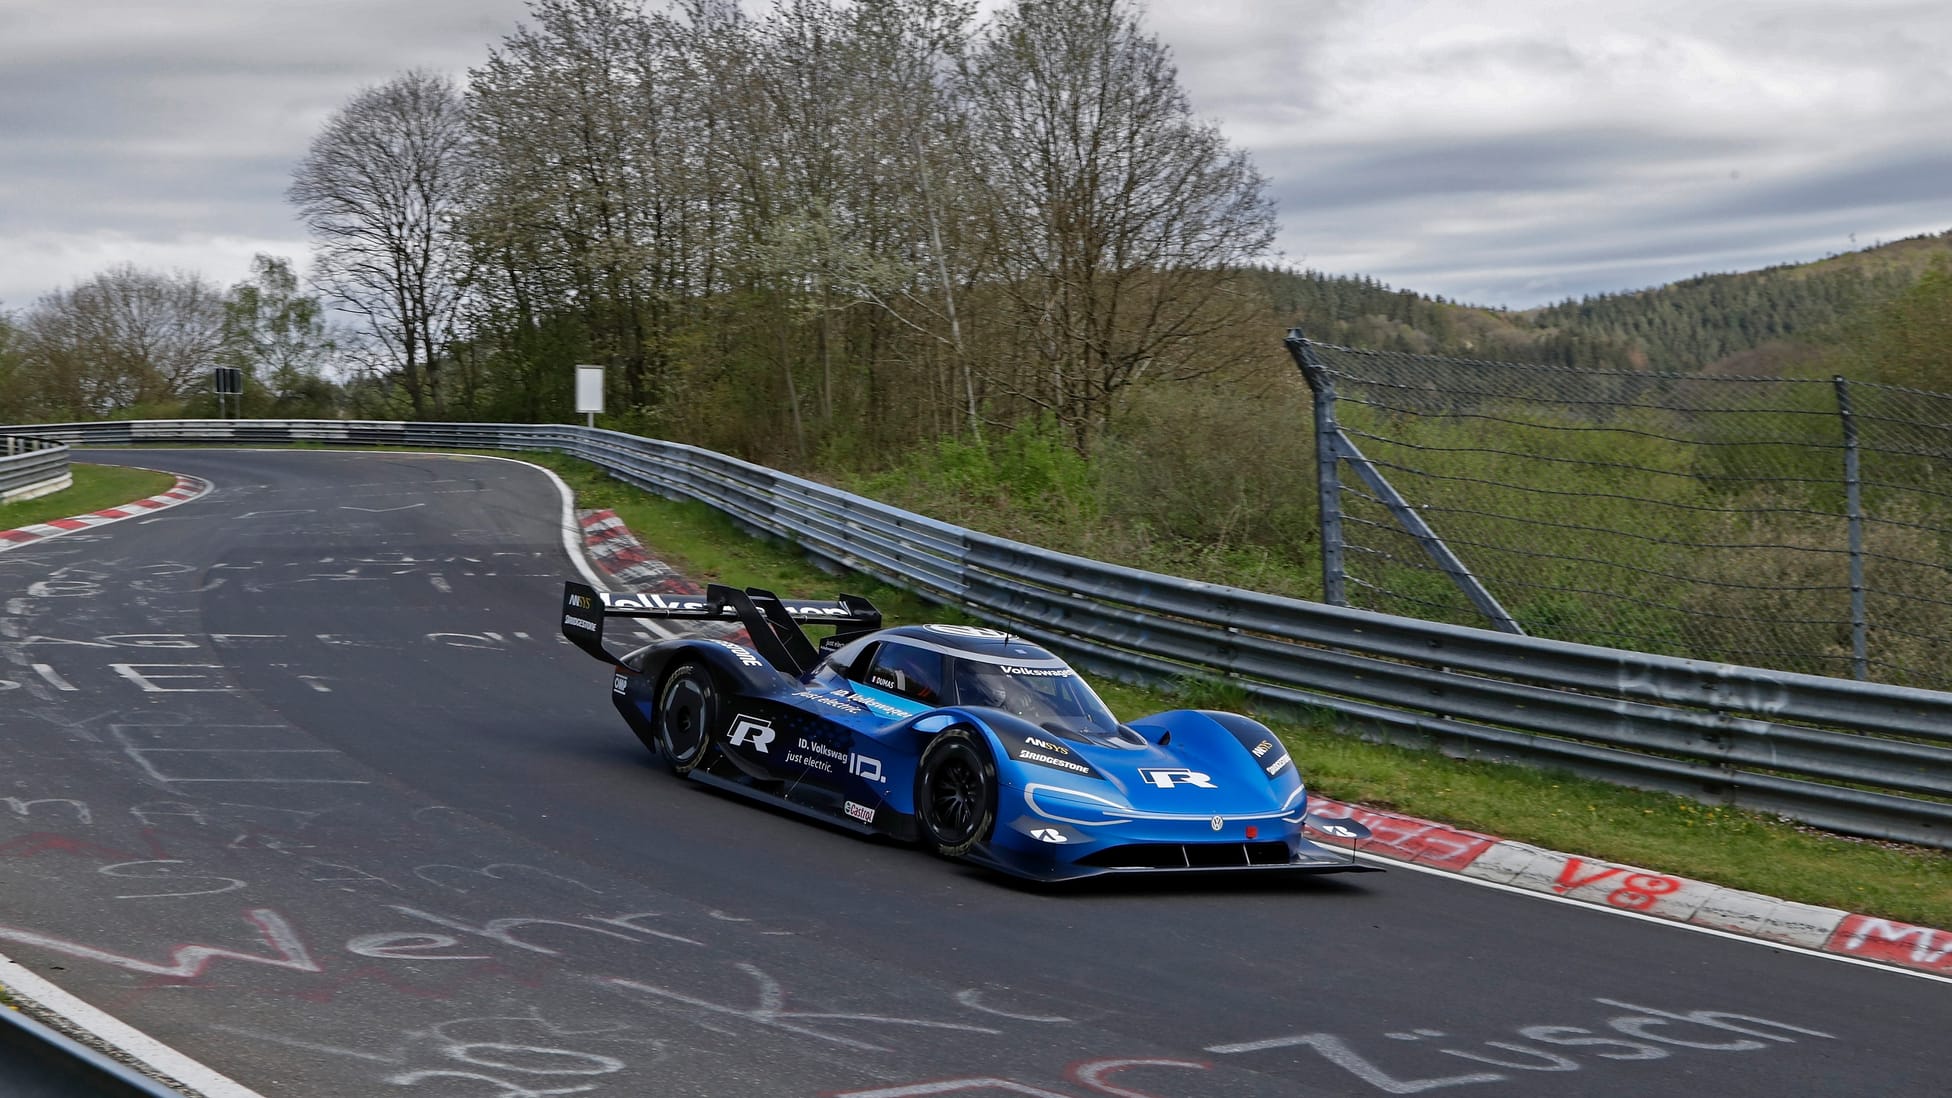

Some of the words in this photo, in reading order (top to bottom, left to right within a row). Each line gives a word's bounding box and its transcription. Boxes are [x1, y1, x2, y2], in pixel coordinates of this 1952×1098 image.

[569, 594, 591, 609] ANSYS
[876, 677, 895, 689] DUMAS
[798, 737, 810, 750] ID.
[1025, 736, 1069, 755] ANSYS
[785, 750, 802, 763] just
[803, 755, 833, 773] electric.
[1019, 749, 1090, 774] BRIDGESTONE
[850, 804, 874, 822] Castrol
[1554, 856, 1681, 912] V8
